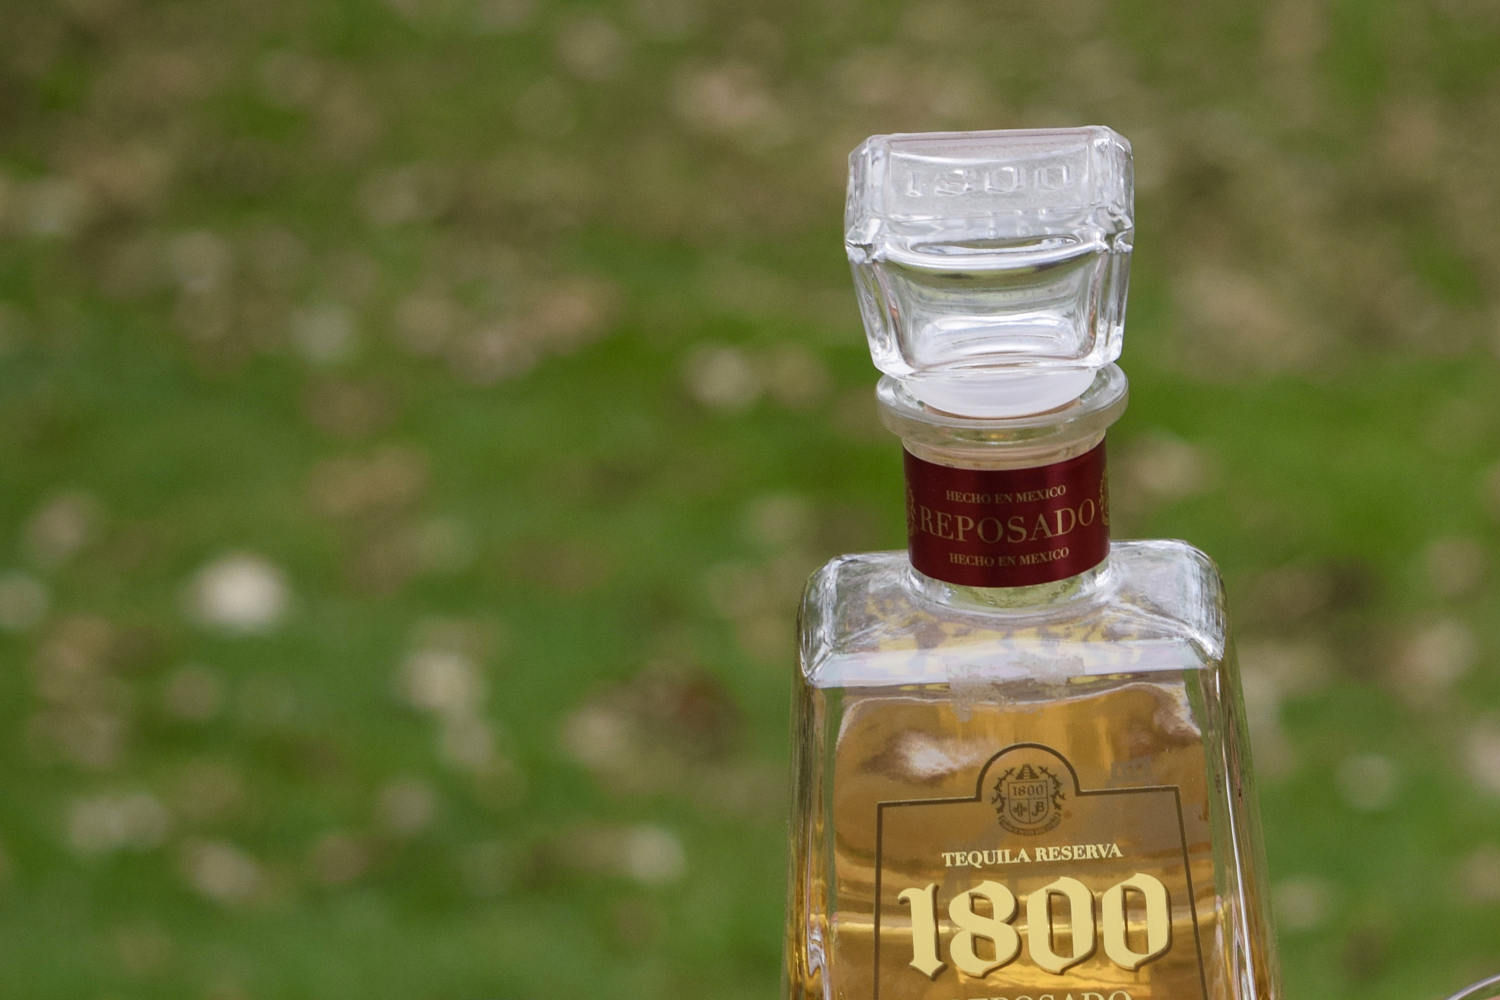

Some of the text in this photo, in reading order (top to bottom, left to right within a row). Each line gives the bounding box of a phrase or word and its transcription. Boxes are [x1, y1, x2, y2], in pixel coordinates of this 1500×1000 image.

[946, 485, 1067, 504] HECHO EN MEXICO
[919, 498, 1096, 544] REPOSADO
[949, 547, 1070, 567] HECHO EN MEXICO
[1012, 785, 1044, 796] 1800
[942, 844, 1124, 869] TEQUILA RESERVA
[898, 873, 1173, 982] 1800
